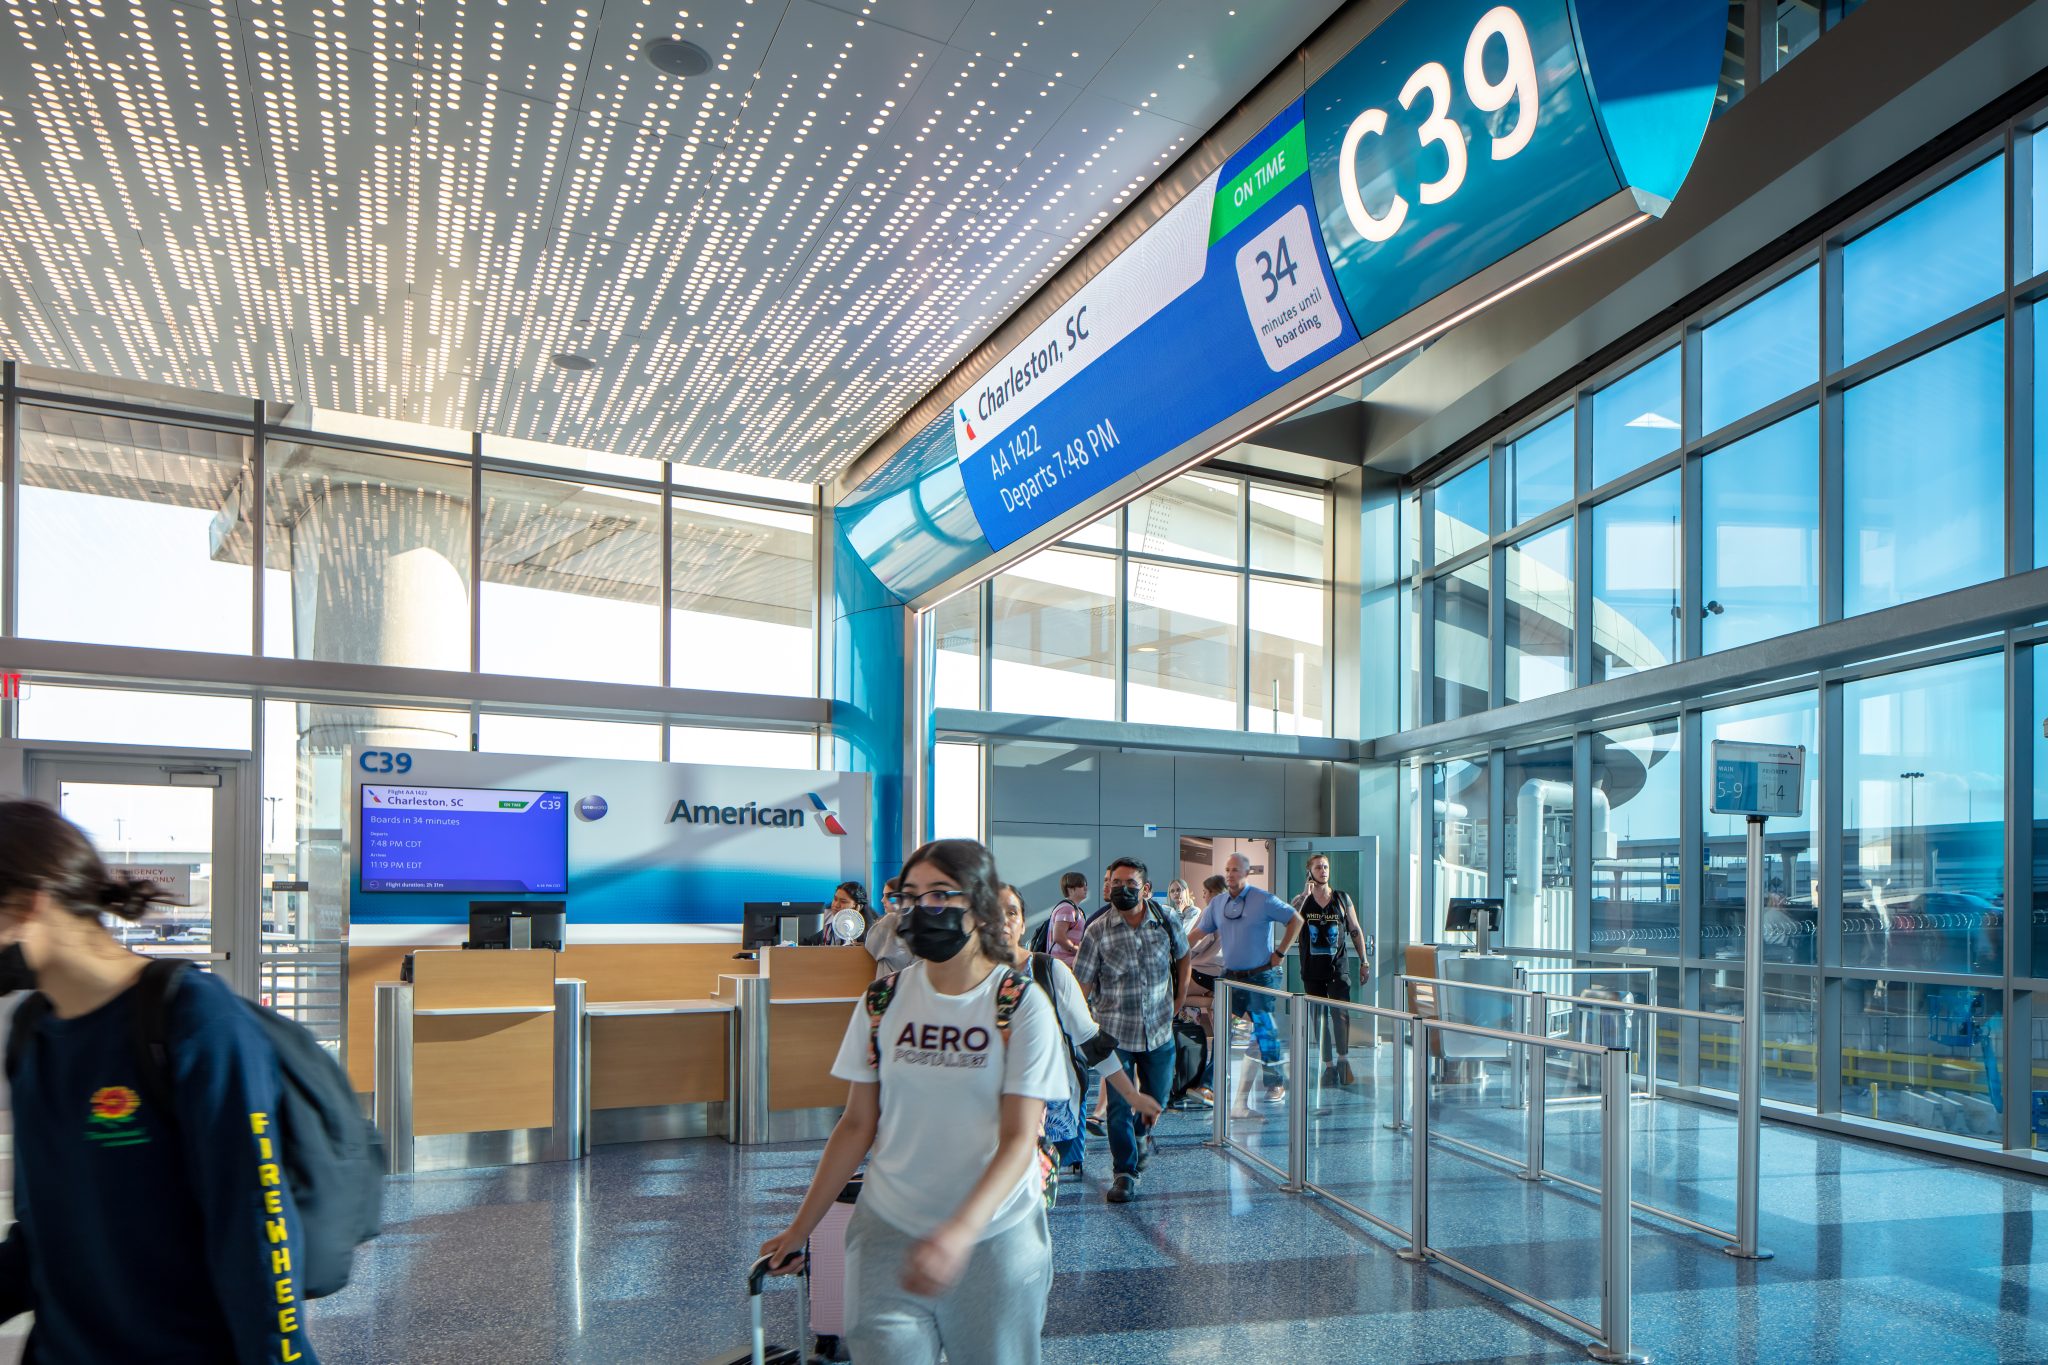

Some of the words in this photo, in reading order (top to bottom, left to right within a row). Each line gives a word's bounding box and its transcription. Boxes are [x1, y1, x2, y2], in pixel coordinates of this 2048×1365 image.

[1339, 6, 1539, 242] C39
[1233, 177, 1253, 207] ON
[1255, 150, 1287, 190] TIME
[1255, 235, 1298, 304] 34
[1261, 305, 1298, 336] minutes
[1299, 287, 1322, 311] until
[1275, 314, 1322, 348] boarding
[978, 340, 1063, 421] Charleston,
[1066, 305, 1090, 351] SC
[990, 454, 1011, 480] AA
[1008, 424, 1041, 465] 1422
[1000, 465, 1058, 513] Departs
[1052, 438, 1089, 479] 7:48
[1086, 418, 1121, 457] PM
[0, 673, 22, 698] IT
[359, 751, 412, 774] C39
[1718, 765, 1734, 773] MAIN
[387, 796, 449, 807] Charleston,
[450, 798, 464, 807] SC
[1718, 781, 1743, 799] 5-9
[1762, 783, 1787, 801] 1-4
[540, 800, 561, 810] C39
[670, 799, 804, 827] American
[370, 815, 401, 824] Boards
[402, 815, 411, 824] in
[413, 816, 423, 825] 34
[425, 817, 460, 826] minutes
[389, 840, 403, 848] PM
[405, 840, 422, 848] CDT
[390, 861, 404, 869] PM
[406, 861, 422, 869] EDT
[896, 1022, 990, 1052] AERO
